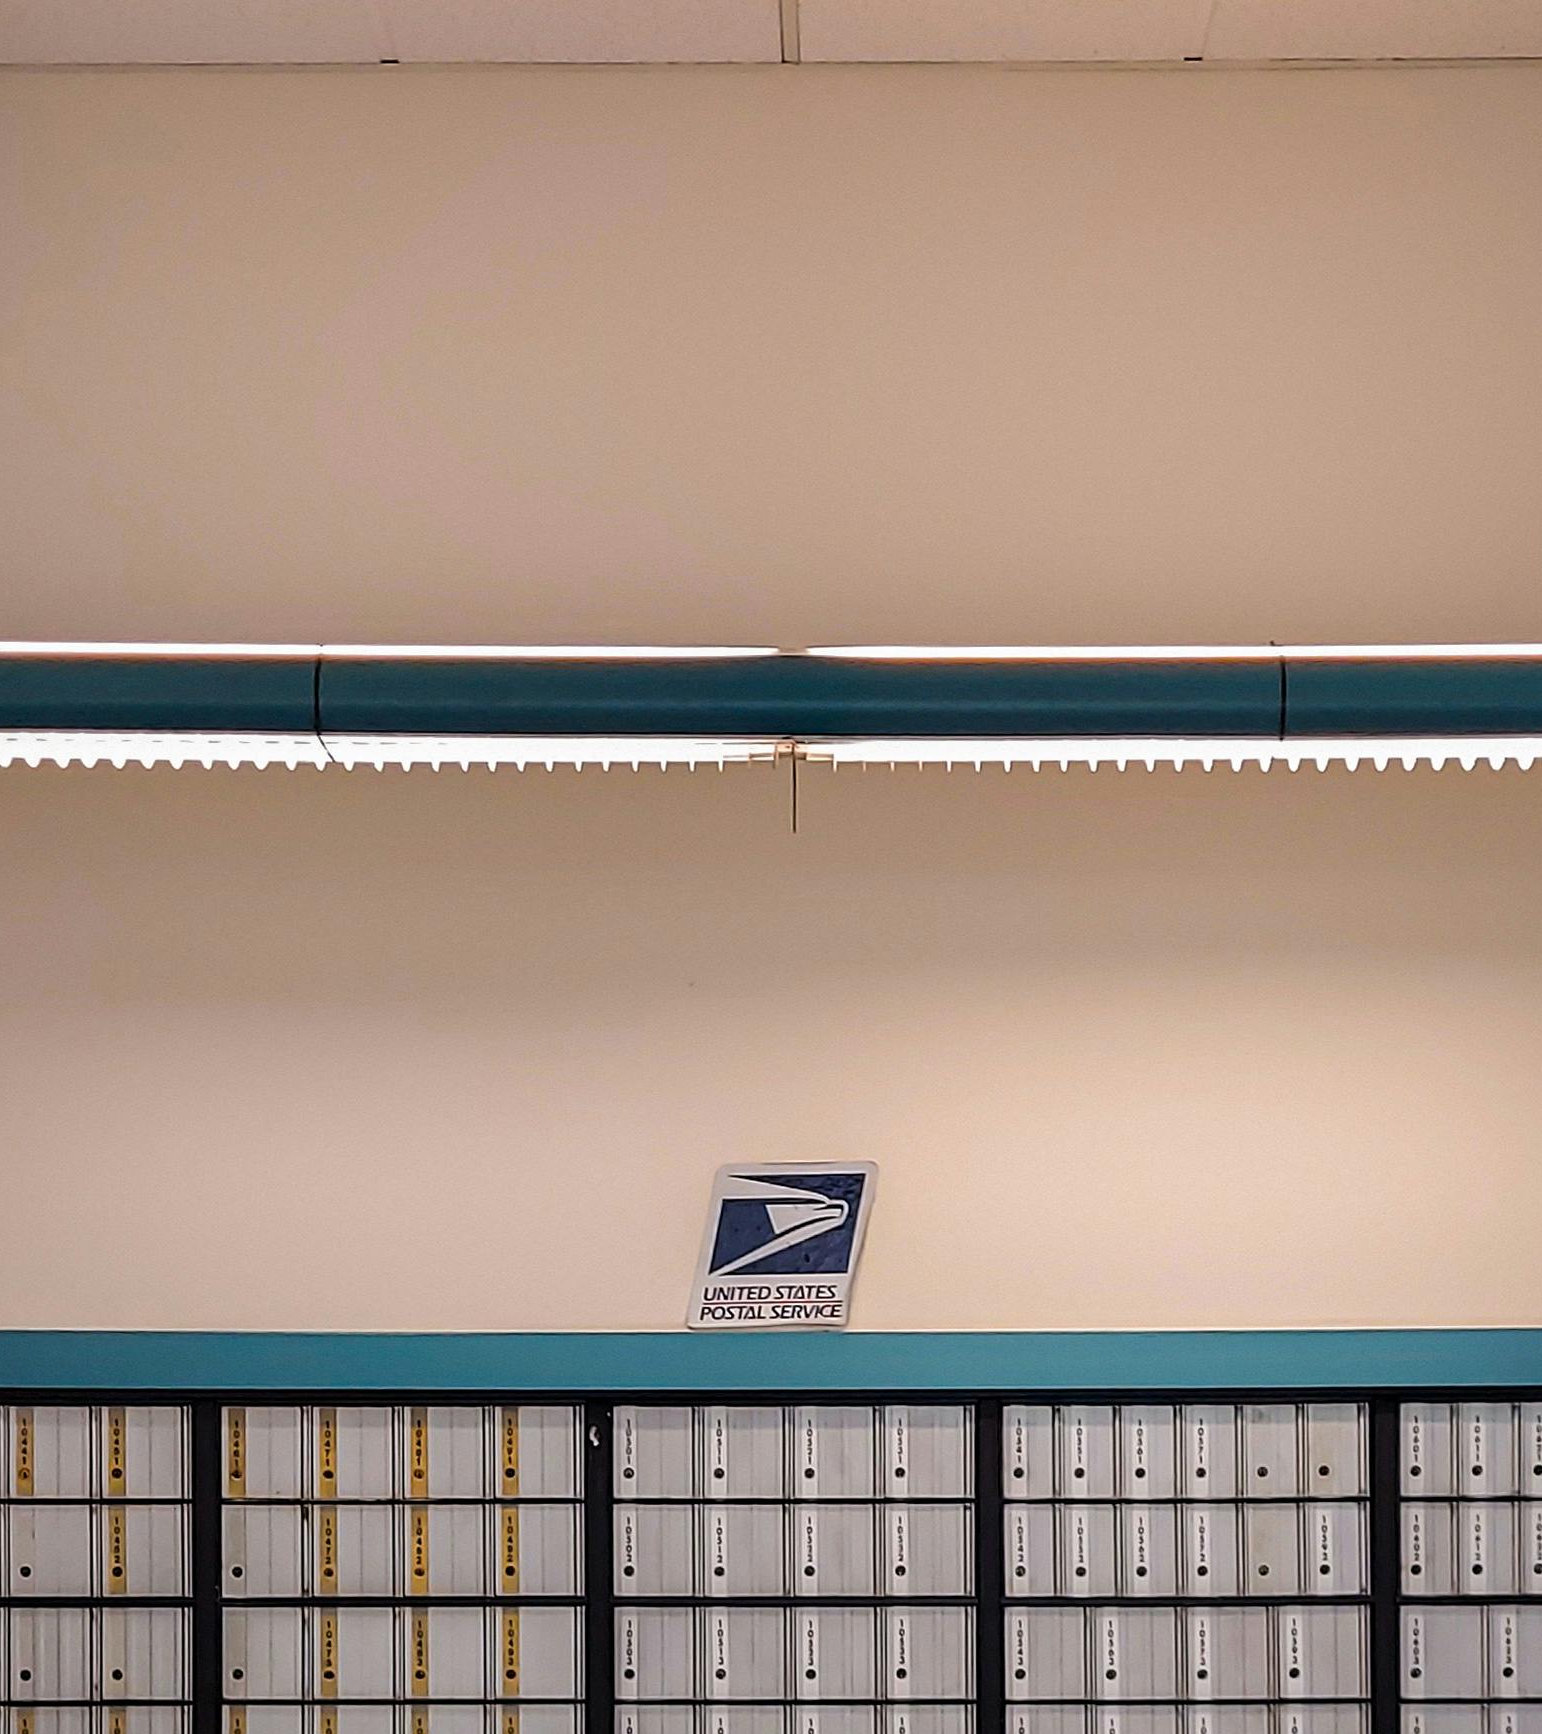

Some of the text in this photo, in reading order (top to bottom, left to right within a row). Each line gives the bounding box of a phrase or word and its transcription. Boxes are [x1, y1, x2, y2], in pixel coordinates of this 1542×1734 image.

[703, 1284, 838, 1302] UNITED STATES
[699, 1303, 844, 1321] POSTAL SERVICE
